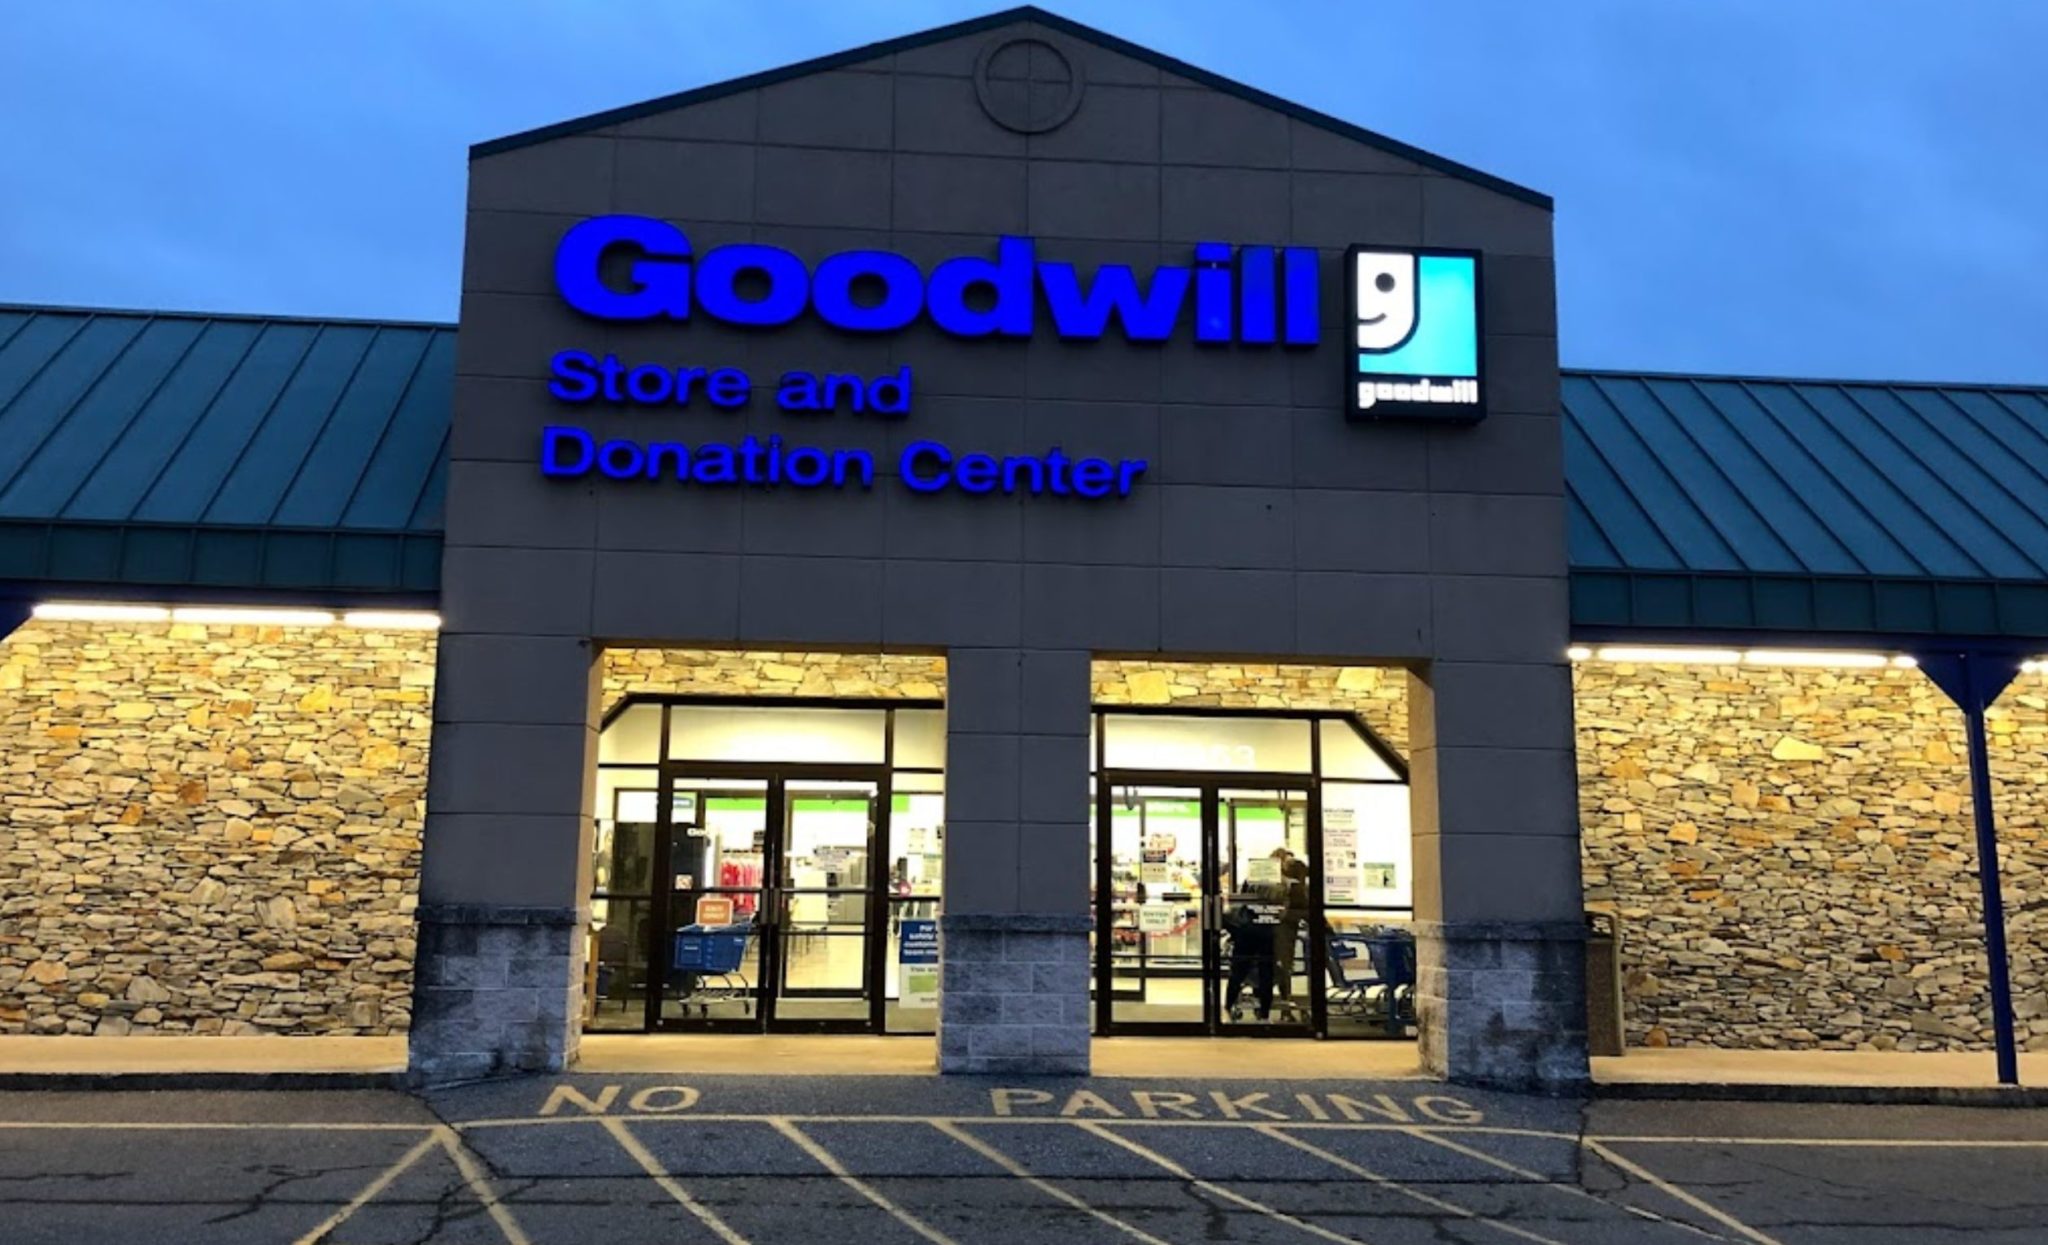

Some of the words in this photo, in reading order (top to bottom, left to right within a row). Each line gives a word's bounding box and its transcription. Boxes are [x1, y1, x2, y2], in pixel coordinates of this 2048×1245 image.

[554, 213, 1320, 345] Goodwill
[548, 350, 752, 411] Store
[776, 365, 912, 417] and
[1358, 378, 1478, 409] goodwill
[541, 424, 875, 488] Donation
[899, 439, 1148, 500] Center
[538, 1084, 701, 1115] NO
[989, 1087, 1485, 1124] PARKING
